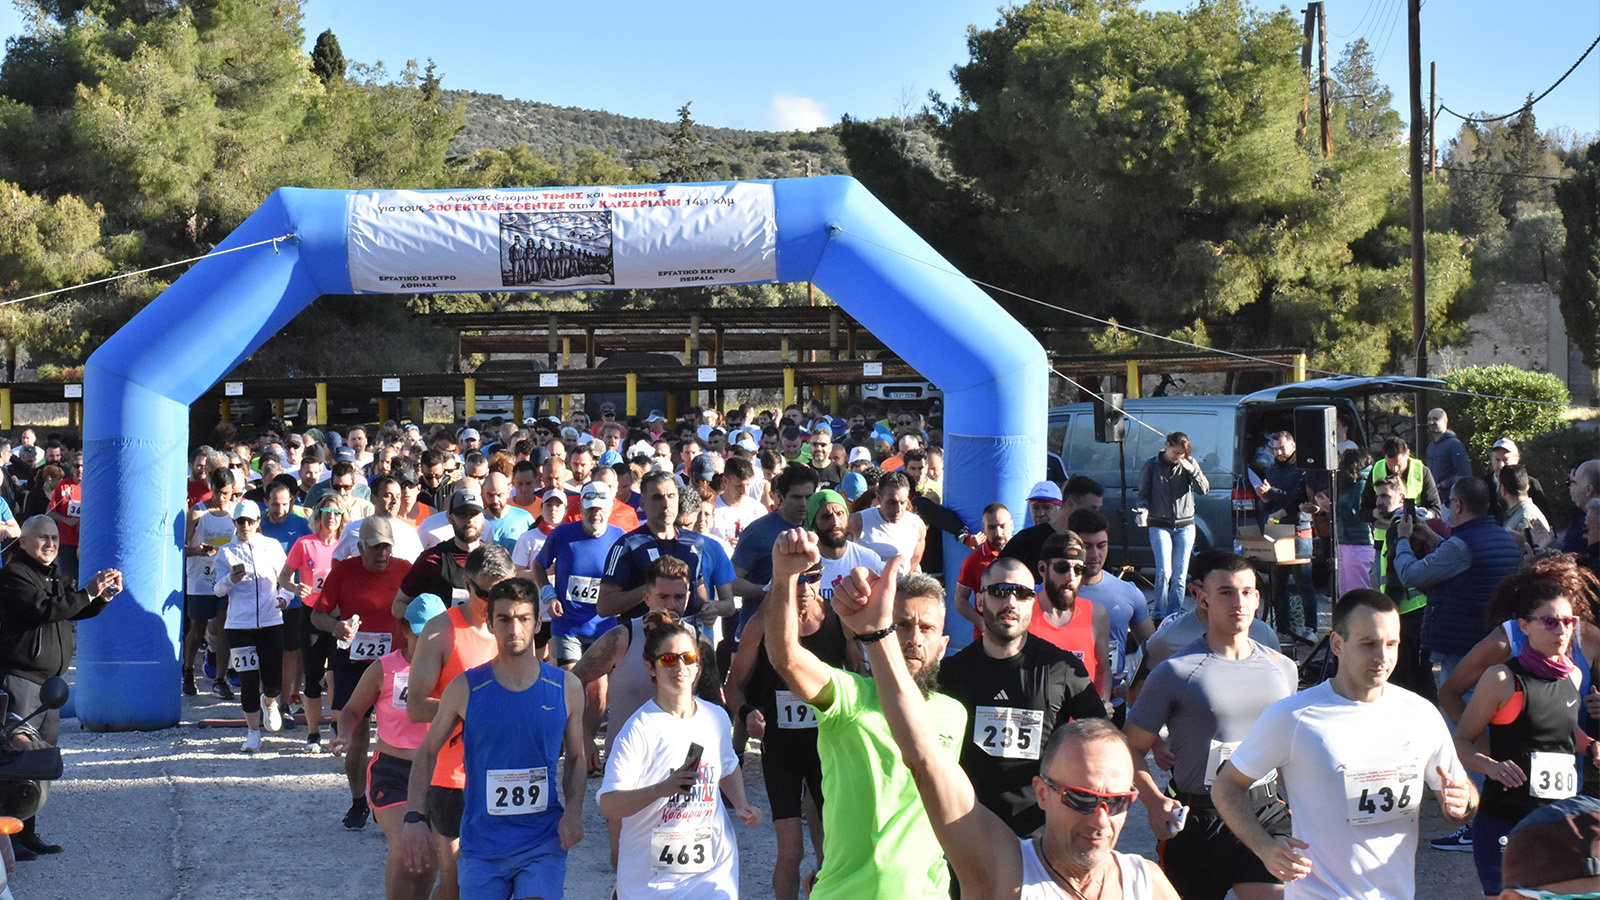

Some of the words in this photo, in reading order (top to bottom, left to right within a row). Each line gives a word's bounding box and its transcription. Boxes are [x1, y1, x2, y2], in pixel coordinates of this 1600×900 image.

[378, 206, 396, 214] για
[399, 205, 424, 213] τους
[428, 203, 452, 212] 200
[455, 201, 565, 211] ΕΚΤΕΛΕΣΘΕΝΤΕΣ
[599, 198, 681, 209] ΚΑΙΣΑΡΙΑΝΗ
[713, 195, 735, 207] χλμ
[447, 193, 491, 203] Αγώνας
[494, 193, 539, 203] δρόμου
[542, 192, 583, 200] ΤΙΜΗΣ
[608, 190, 666, 199] ΜΝΗΜΗΣ
[571, 585, 598, 599] 462
[355, 642, 386, 657] 423
[234, 655, 256, 668] 216
[983, 725, 1031, 750] 235
[1539, 770, 1573, 792] 380
[495, 785, 540, 807] 289
[1358, 785, 1411, 814] 436
[659, 843, 705, 865] 463
